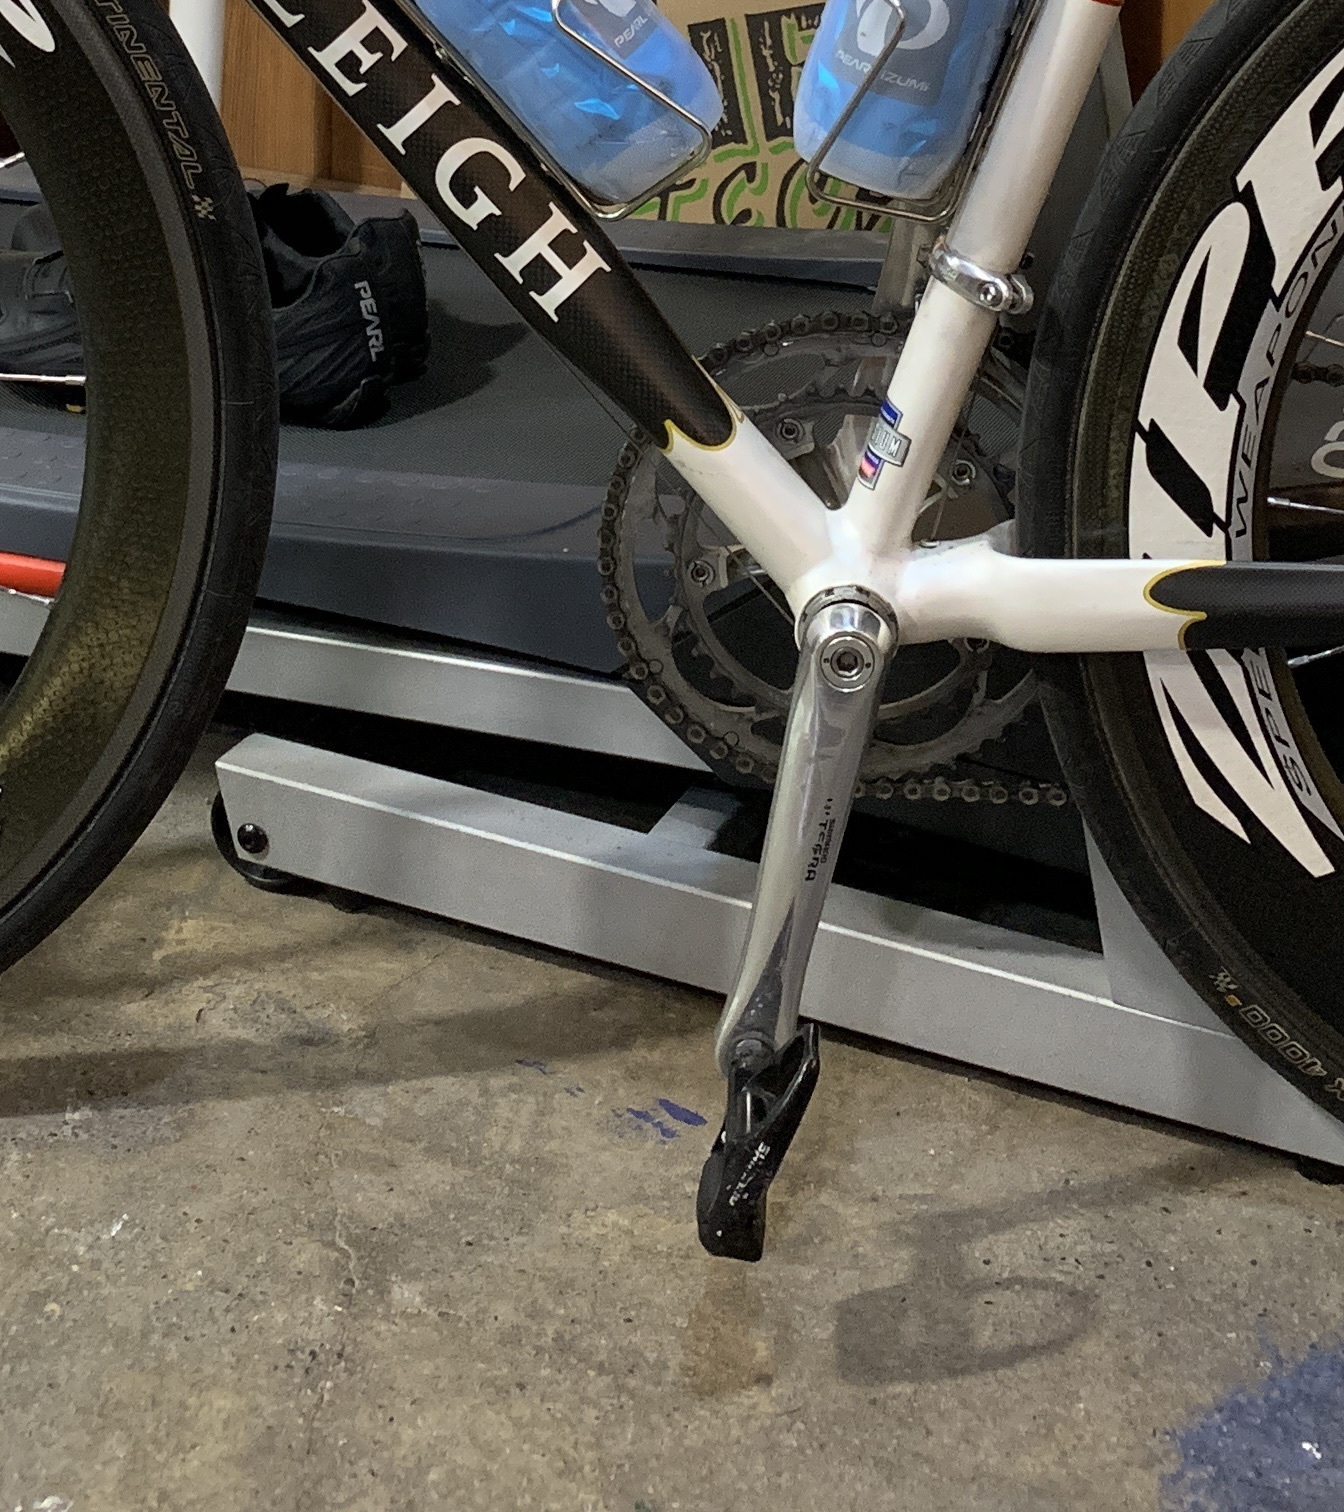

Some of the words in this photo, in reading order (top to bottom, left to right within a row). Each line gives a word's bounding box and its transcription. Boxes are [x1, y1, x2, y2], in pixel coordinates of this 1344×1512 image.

[613, 14, 650, 49] PEARL
[837, 49, 872, 74] PEAR
[353, 279, 386, 363] PEARL
[1238, 1003, 1328, 1079] 4000
